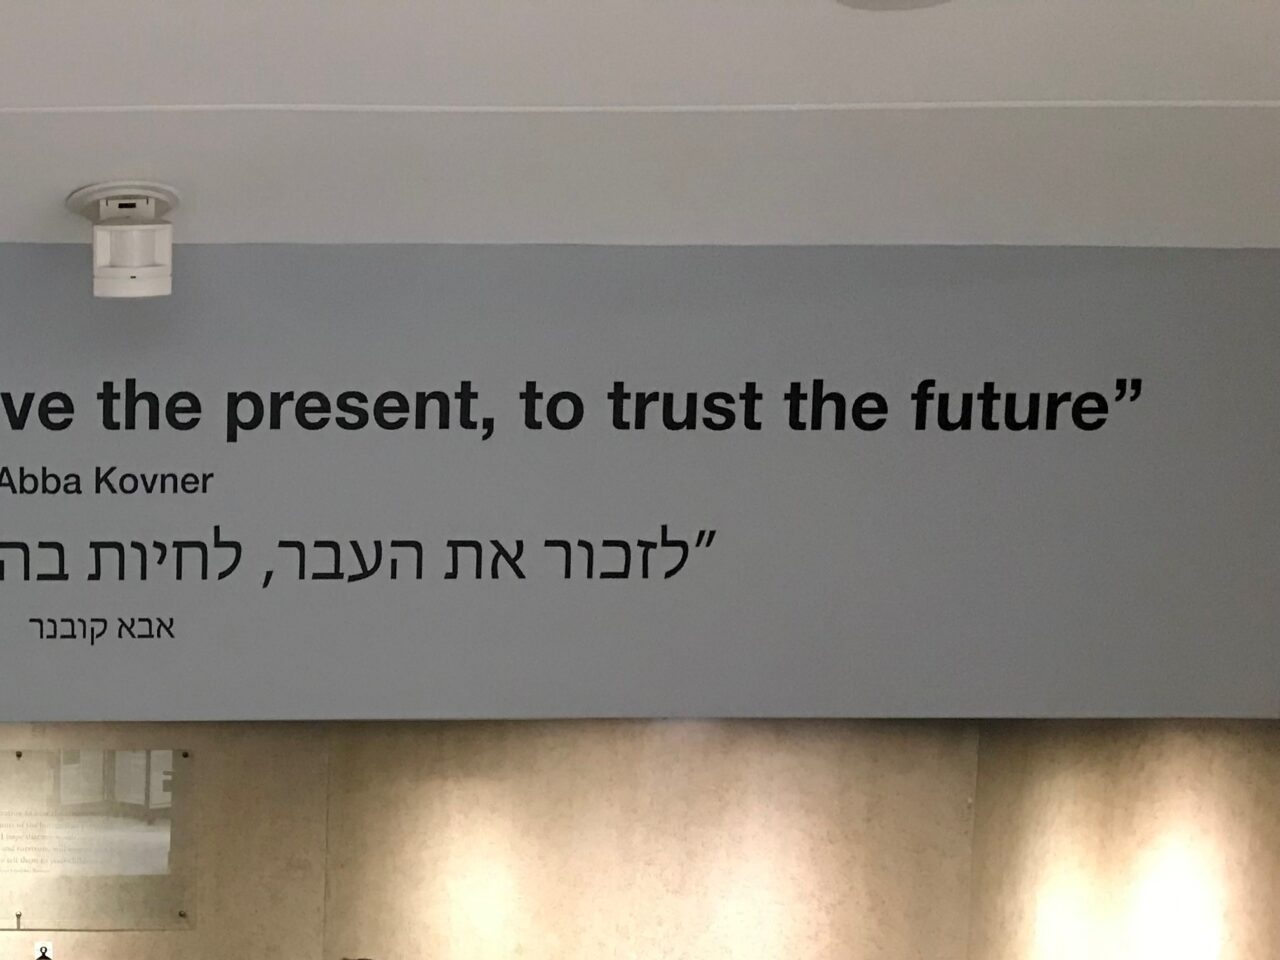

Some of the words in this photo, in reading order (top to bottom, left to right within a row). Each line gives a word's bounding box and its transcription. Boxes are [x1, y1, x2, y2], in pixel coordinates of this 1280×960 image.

[97, 378, 202, 431] the
[227, 381, 494, 443] present,
[519, 381, 584, 430] to
[607, 381, 763, 431] trust
[784, 379, 888, 431] the
[911, 378, 1142, 431] future”
[95, 466, 214, 494] Kovner
[87, 525, 242, 580] לחיות
[263, 540, 423, 588] העבר,
[444, 540, 526, 579] את
[29, 618, 107, 646] קובנר
[118, 618, 175, 638] אבא
